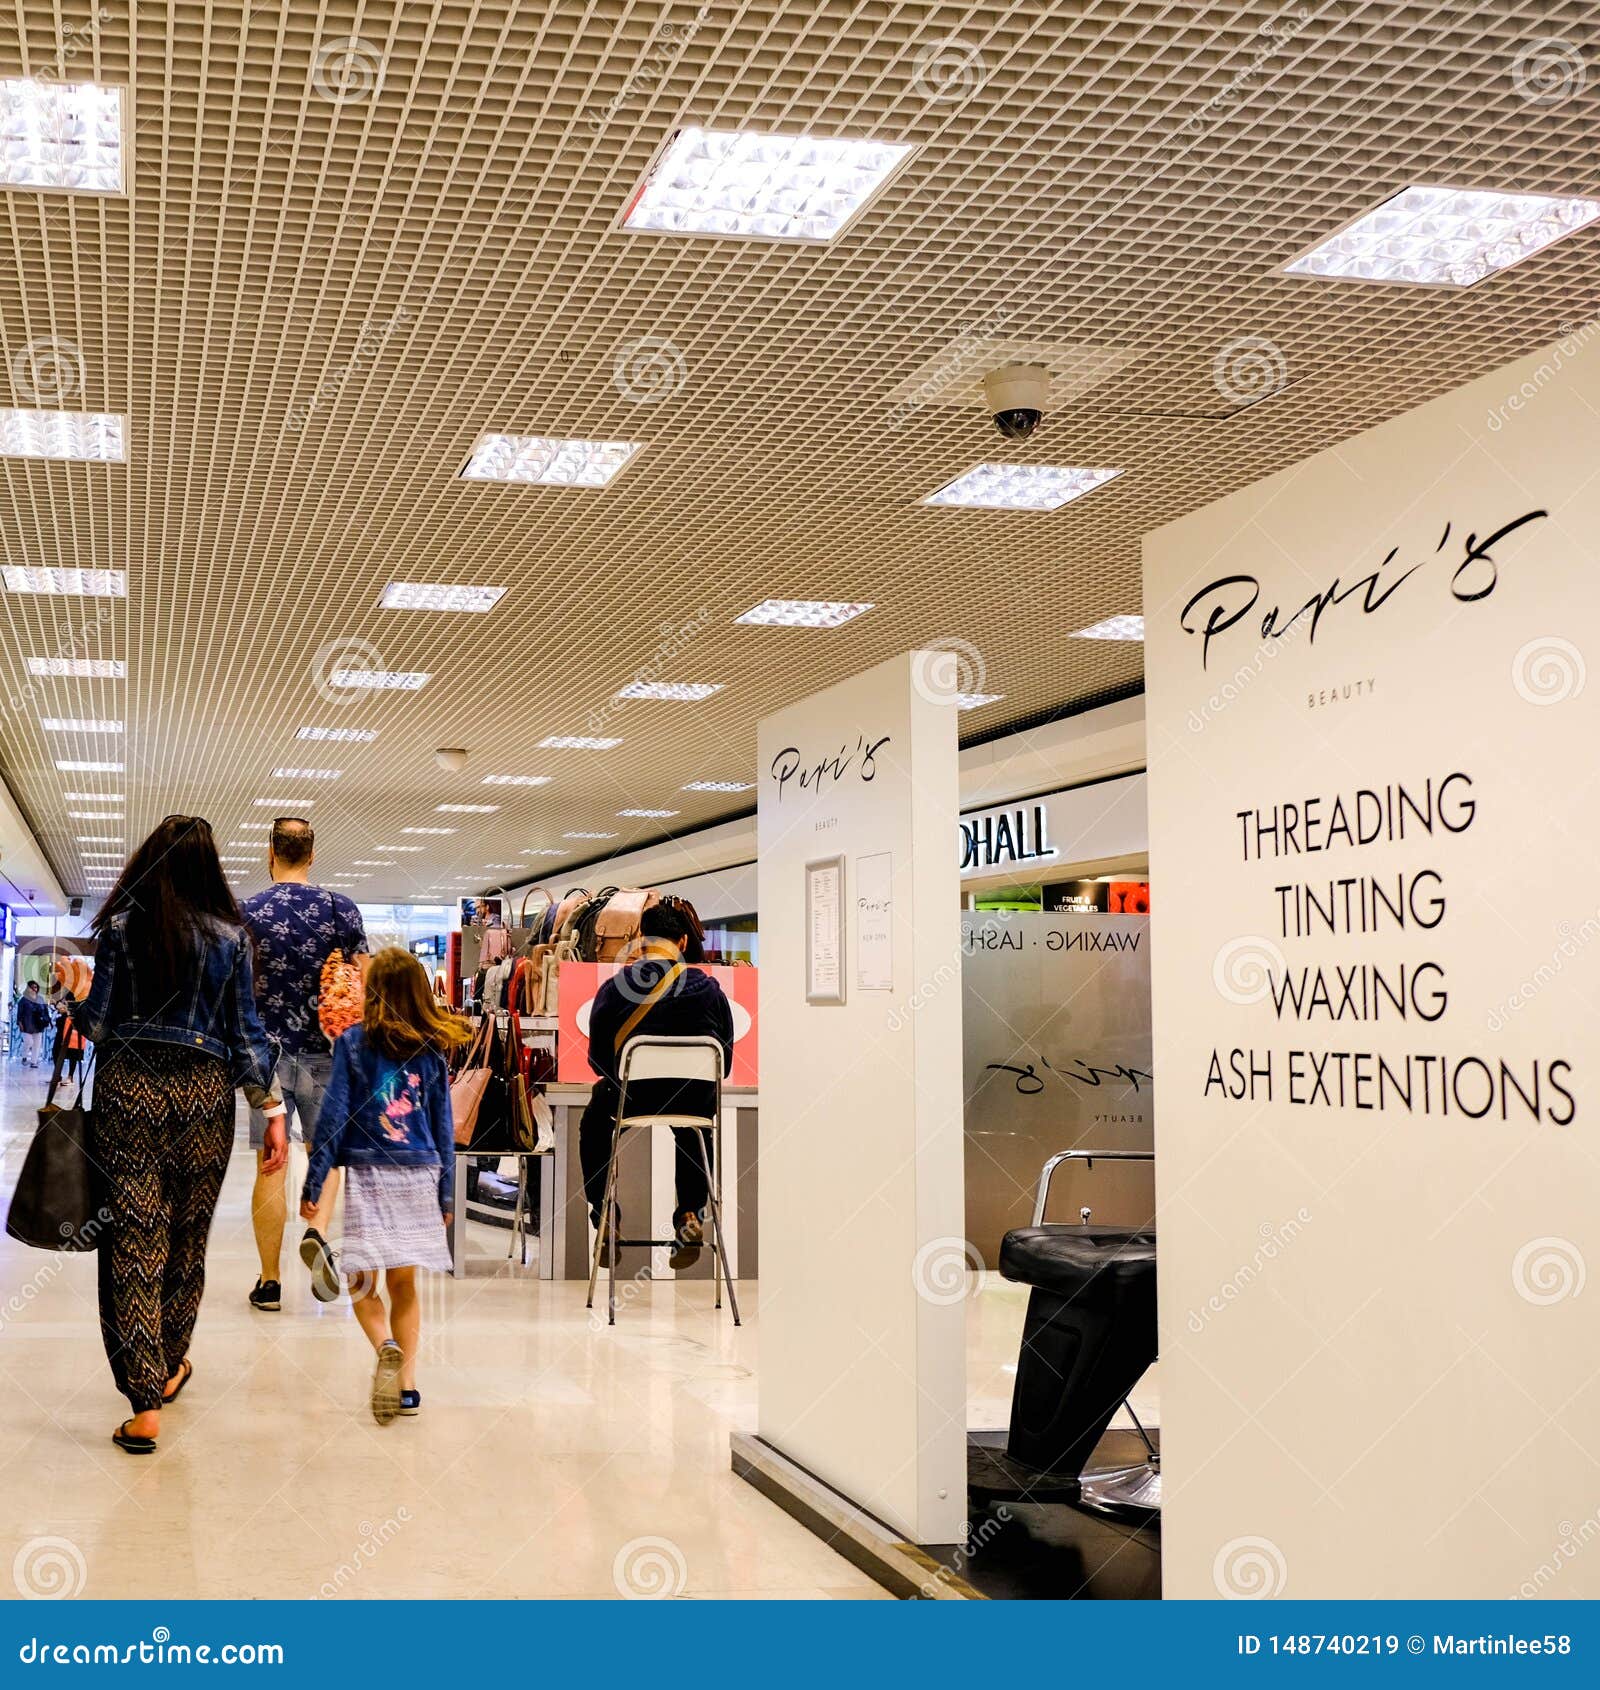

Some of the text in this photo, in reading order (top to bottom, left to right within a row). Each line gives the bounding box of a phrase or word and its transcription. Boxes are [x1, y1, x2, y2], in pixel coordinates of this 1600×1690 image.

[1308, 678, 1376, 709] BEAUTY
[1237, 772, 1476, 861] THREADING
[1275, 869, 1446, 938] TINTING
[1267, 962, 1448, 1022] WAXING
[1204, 1048, 1576, 1126] ASH EXTENTIONS
